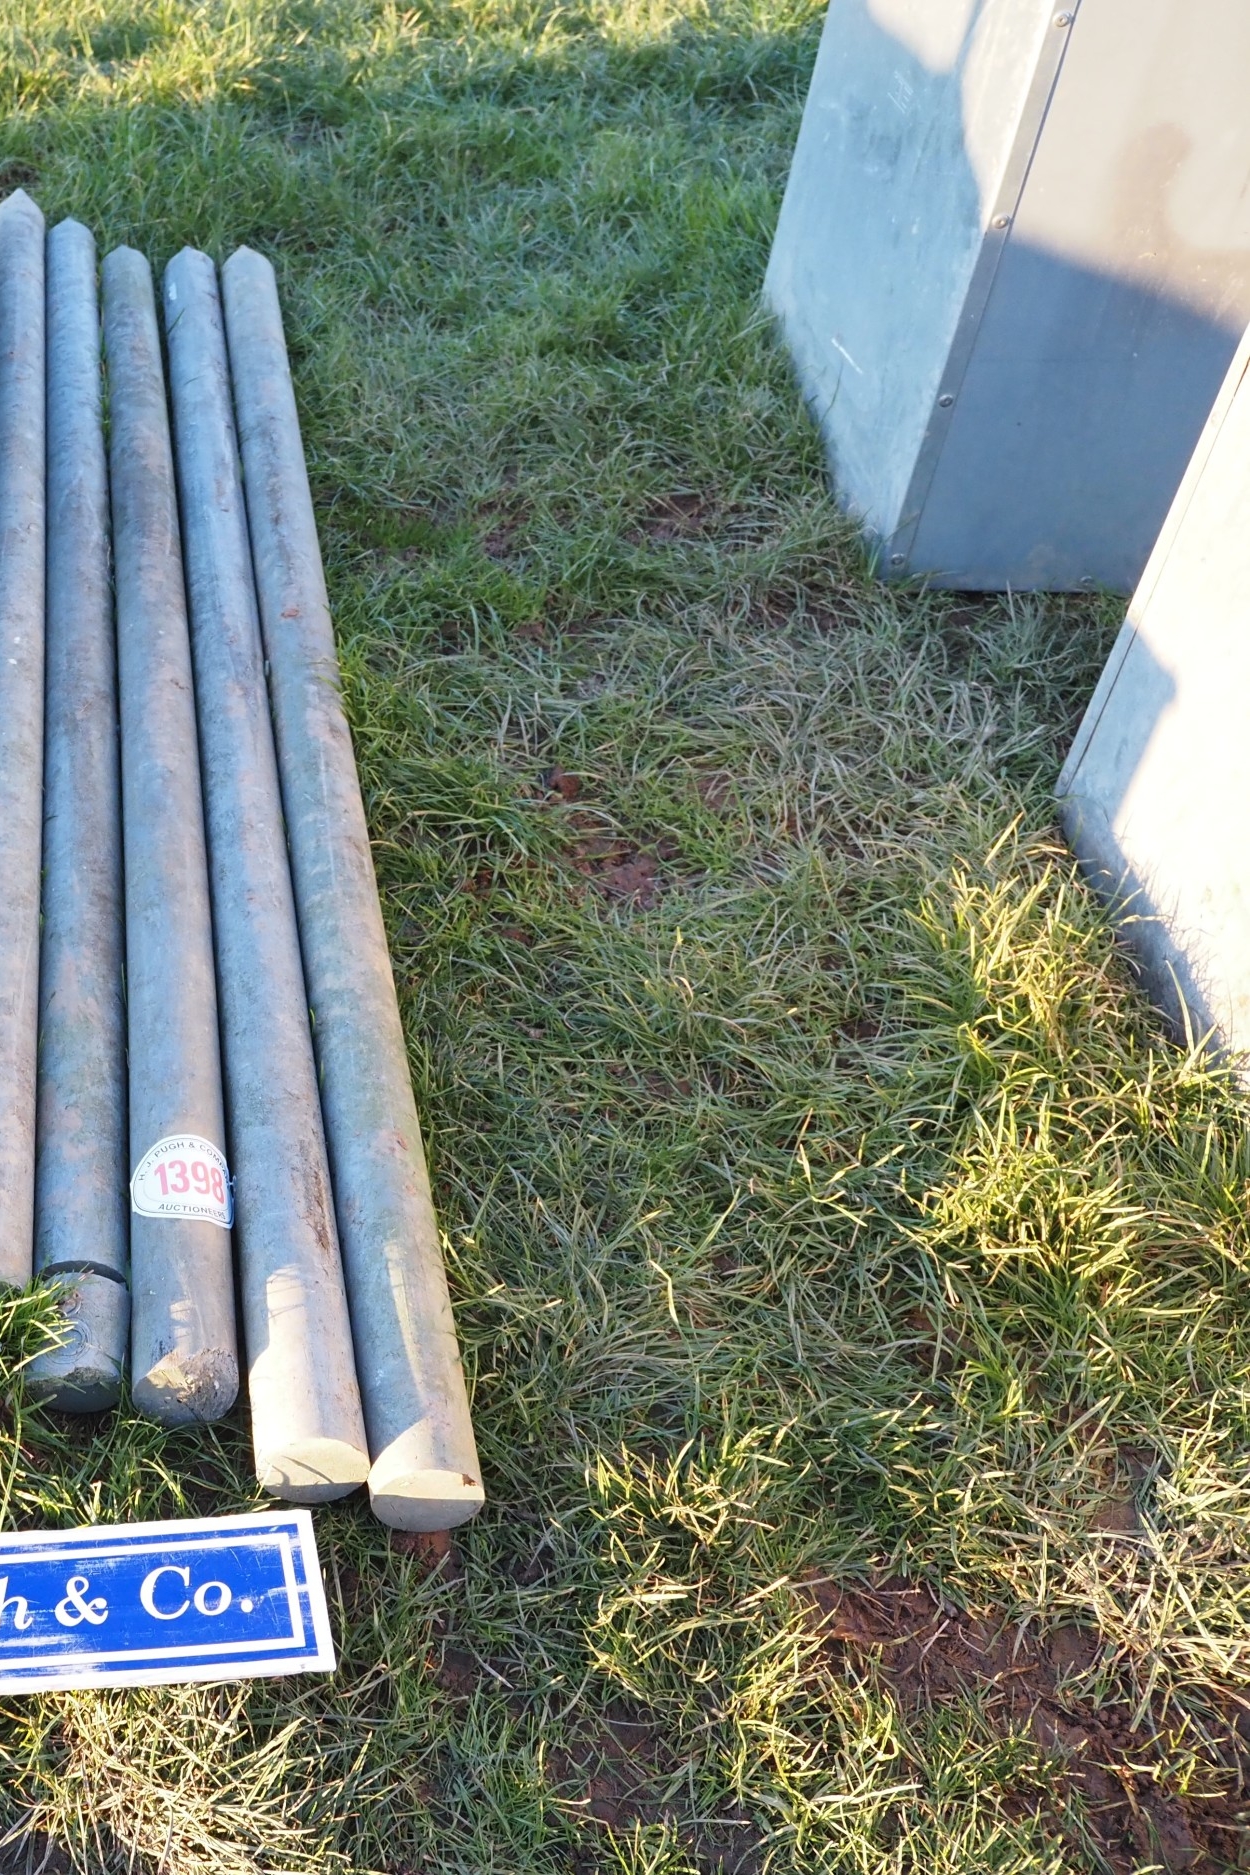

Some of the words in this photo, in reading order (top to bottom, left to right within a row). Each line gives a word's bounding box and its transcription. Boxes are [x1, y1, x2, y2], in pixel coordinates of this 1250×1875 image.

[154, 1142, 184, 1158] PUGH
[154, 1160, 224, 1204] 1398
[158, 1204, 226, 1220] AUCTIONEERS
[54, 1575, 109, 1626] &
[139, 1566, 255, 1622] Co.
